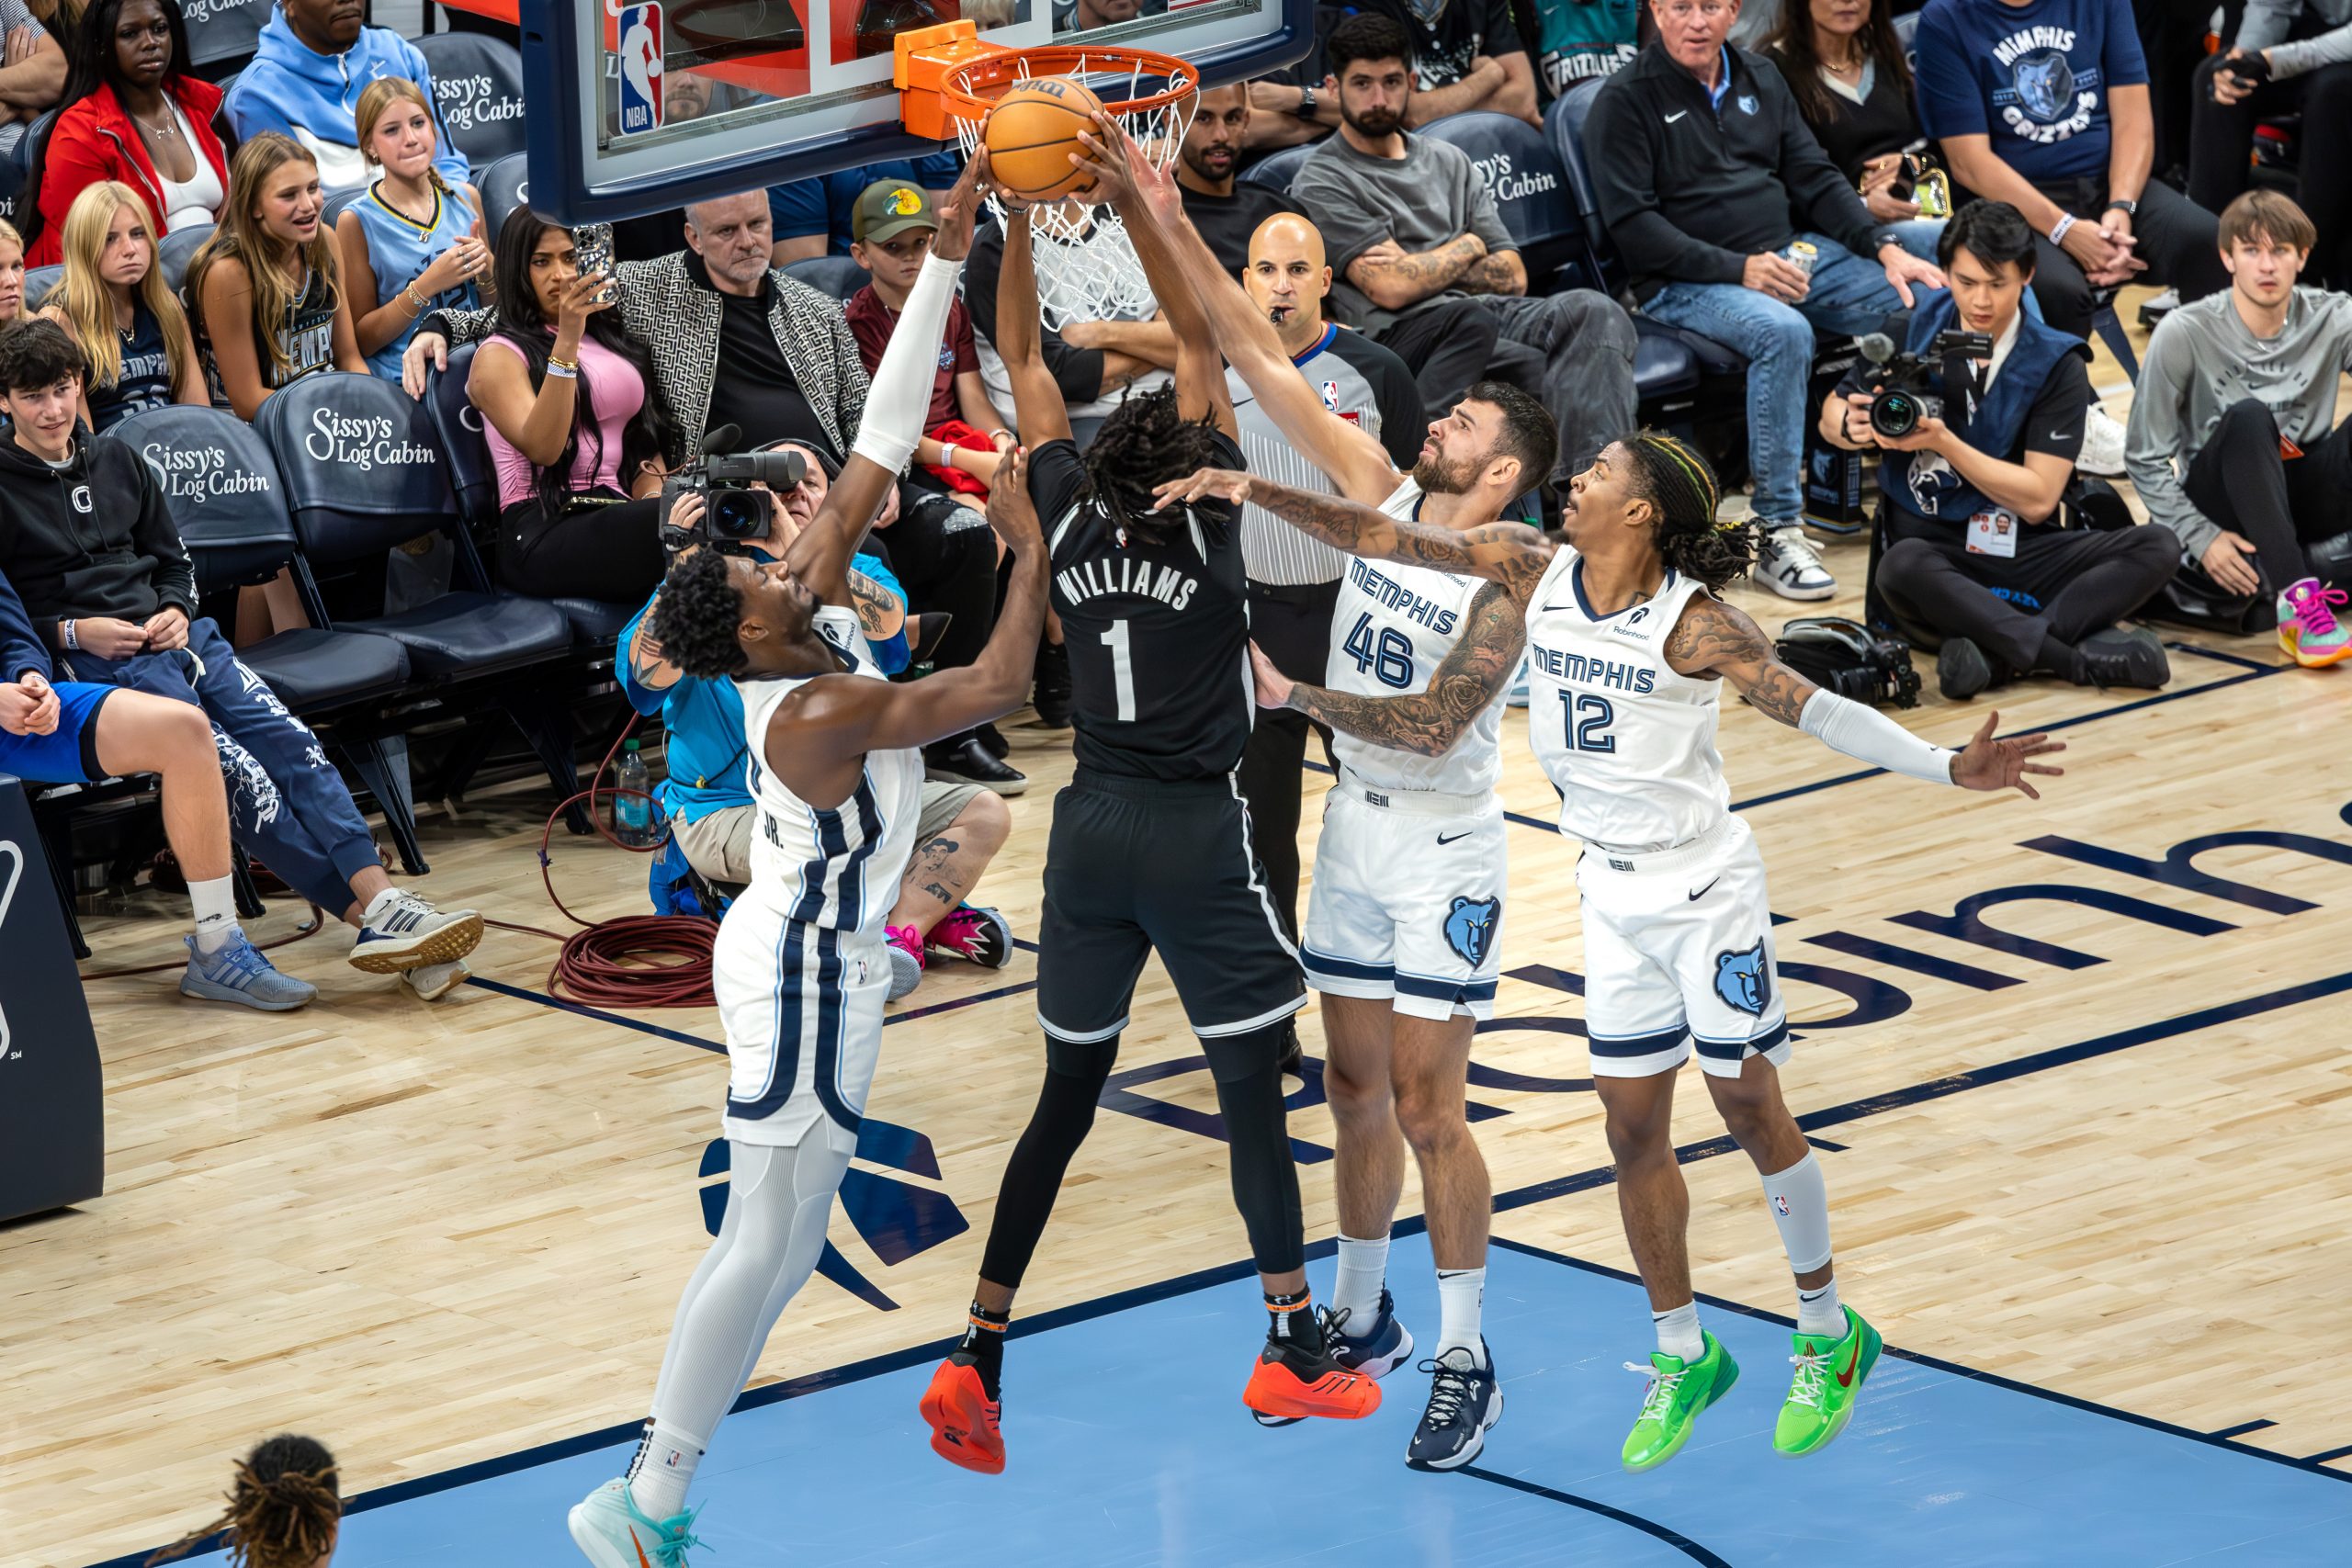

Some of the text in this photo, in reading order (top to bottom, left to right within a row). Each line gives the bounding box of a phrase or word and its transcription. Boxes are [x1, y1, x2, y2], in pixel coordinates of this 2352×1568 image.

[183, 1, 209, 22] og
[432, 74, 492, 107] issy's
[474, 96, 526, 122] Cabi
[626, 105, 648, 129] NBA
[1497, 172, 1558, 201] Cabin
[305, 407, 393, 461] Sissy's
[141, 443, 226, 493] Sissy's
[337, 441, 436, 471] Log Cabin
[171, 469, 270, 503] Log Cabin
[1057, 558, 1198, 611] WILLIAMS
[1350, 556, 1459, 636] MEMPHIS
[1341, 611, 1414, 689] 46
[1612, 626, 1651, 641] Robinhood
[1101, 619, 1136, 722] 1
[1532, 643, 1657, 694] MEMPHIS
[1558, 688, 1616, 754] 12
[763, 809, 785, 850] JR.
[10, 1050, 22, 1060] SM
